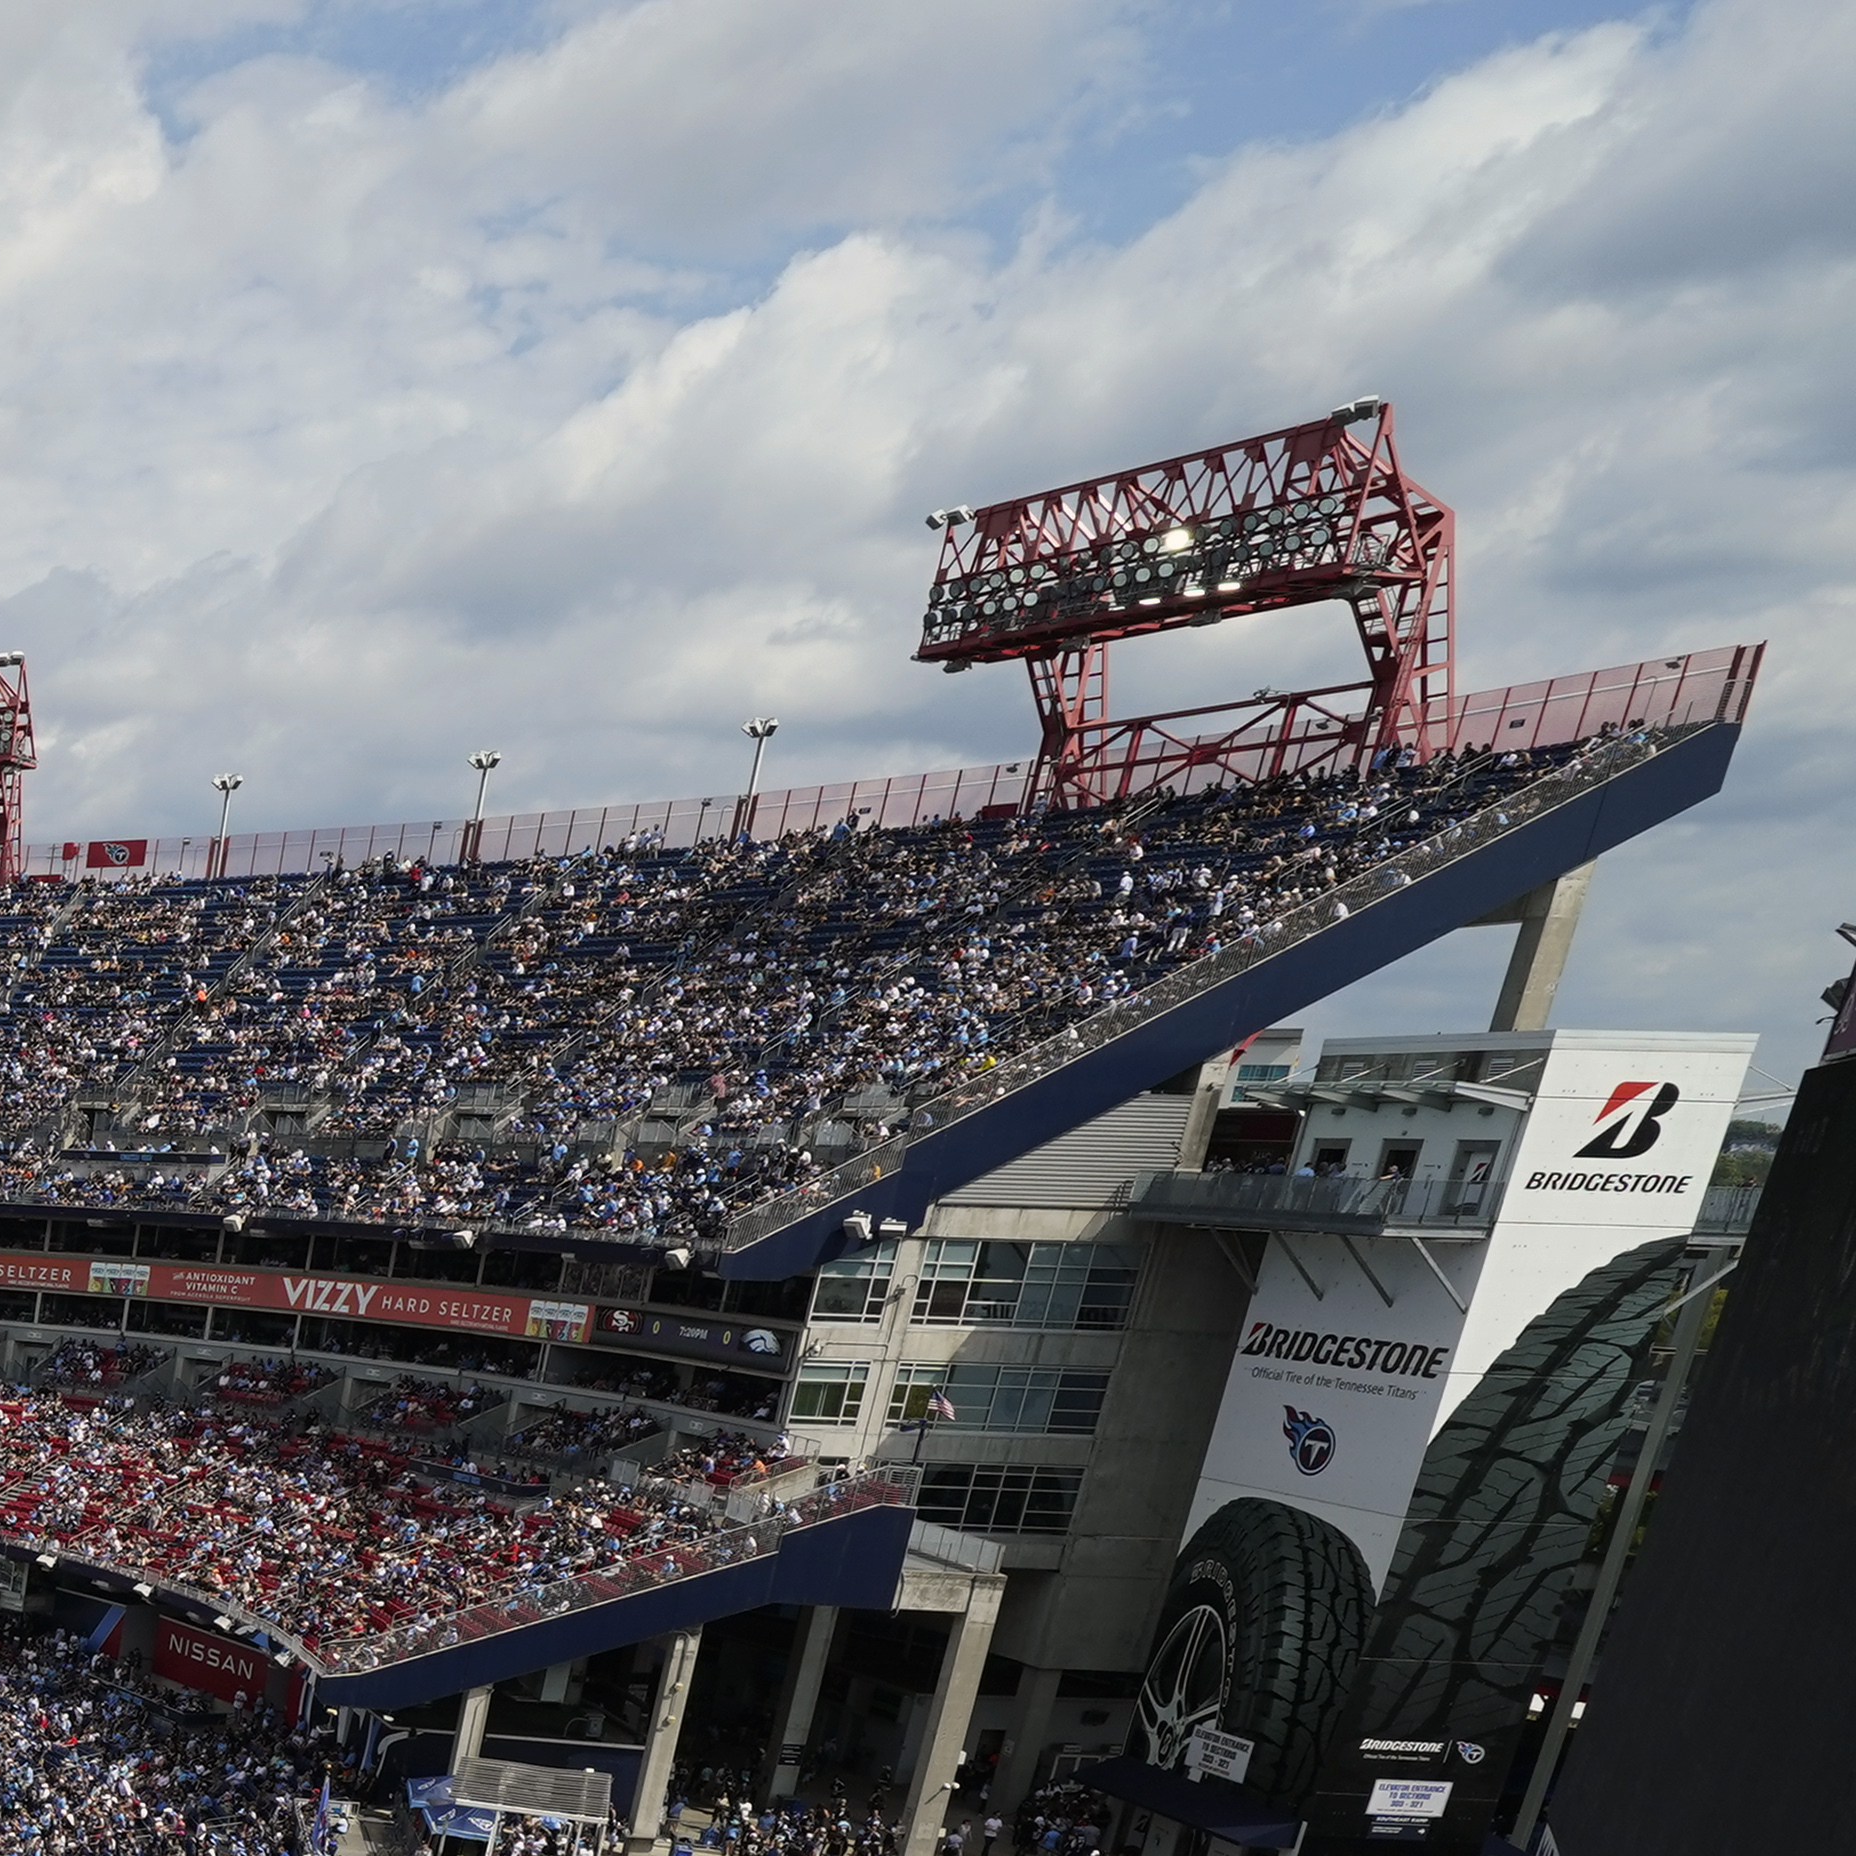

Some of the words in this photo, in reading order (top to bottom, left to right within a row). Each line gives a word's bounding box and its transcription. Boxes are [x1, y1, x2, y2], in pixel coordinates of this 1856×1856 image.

[1525, 1171, 1694, 1194] BRIDGESTONE
[185, 1271, 256, 1286] ANTIOXIDANT
[185, 1281, 228, 1294] VITAMIN
[231, 1285, 238, 1295] C
[283, 1277, 379, 1315] VIZZY
[382, 1295, 430, 1314] HARD
[438, 1301, 512, 1323] SELTZER
[1240, 1321, 1450, 1380] BRIDGESTONE
[1251, 1366, 1283, 1381] Official
[1286, 1371, 1302, 1384] Tire
[1304, 1374, 1315, 1386] of
[1316, 1375, 1332, 1388] the
[1336, 1378, 1384, 1396] Tennessee
[1387, 1384, 1420, 1401] Titans
[167, 1633, 255, 1681] NISSAN
[1359, 1738, 1445, 1754] BRIDGESTONE
